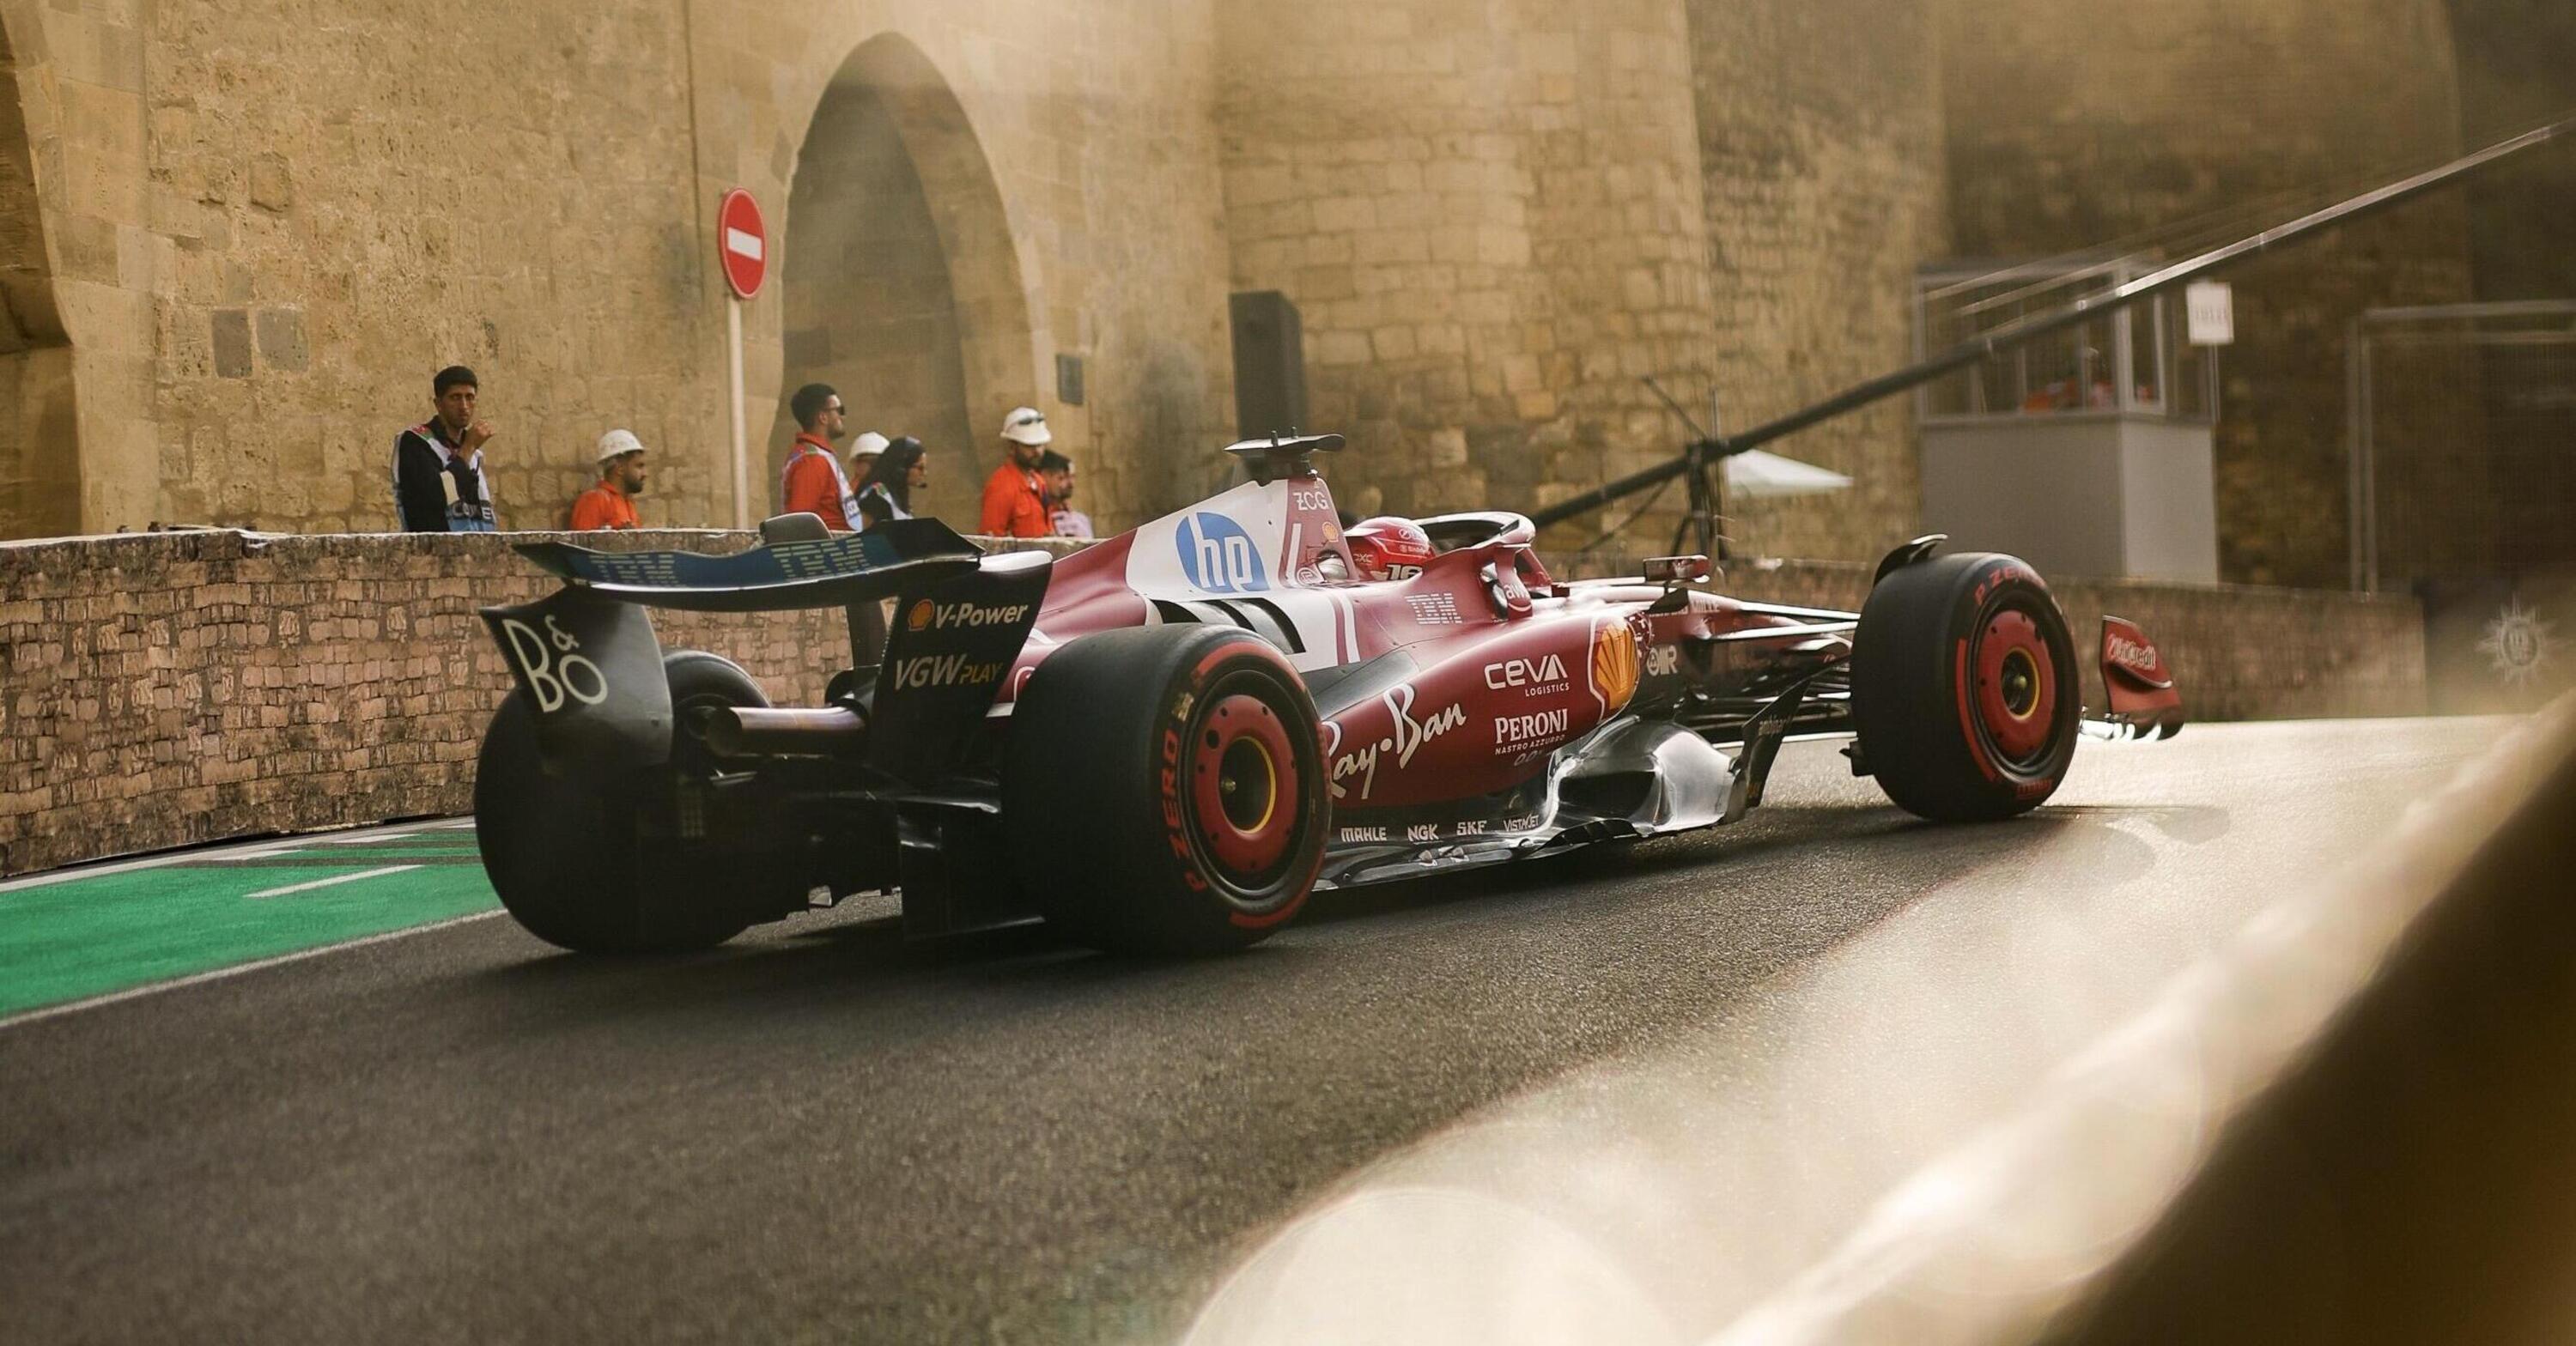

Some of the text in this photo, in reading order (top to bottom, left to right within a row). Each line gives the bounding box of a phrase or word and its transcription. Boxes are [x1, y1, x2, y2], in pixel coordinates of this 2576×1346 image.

[770, 537, 871, 581] IBM
[1188, 512, 1254, 593] hp
[935, 603, 1029, 629] V-Power
[1404, 592, 1463, 624] IBM
[1524, 682, 1571, 697] LOGISTICS
[1494, 708, 1569, 744] PERONI
[1495, 742, 1528, 756] NASTRO
[1340, 827, 1388, 843] MAHLE
[1407, 823, 1440, 842] NGK
[1456, 819, 1488, 837] SKF
